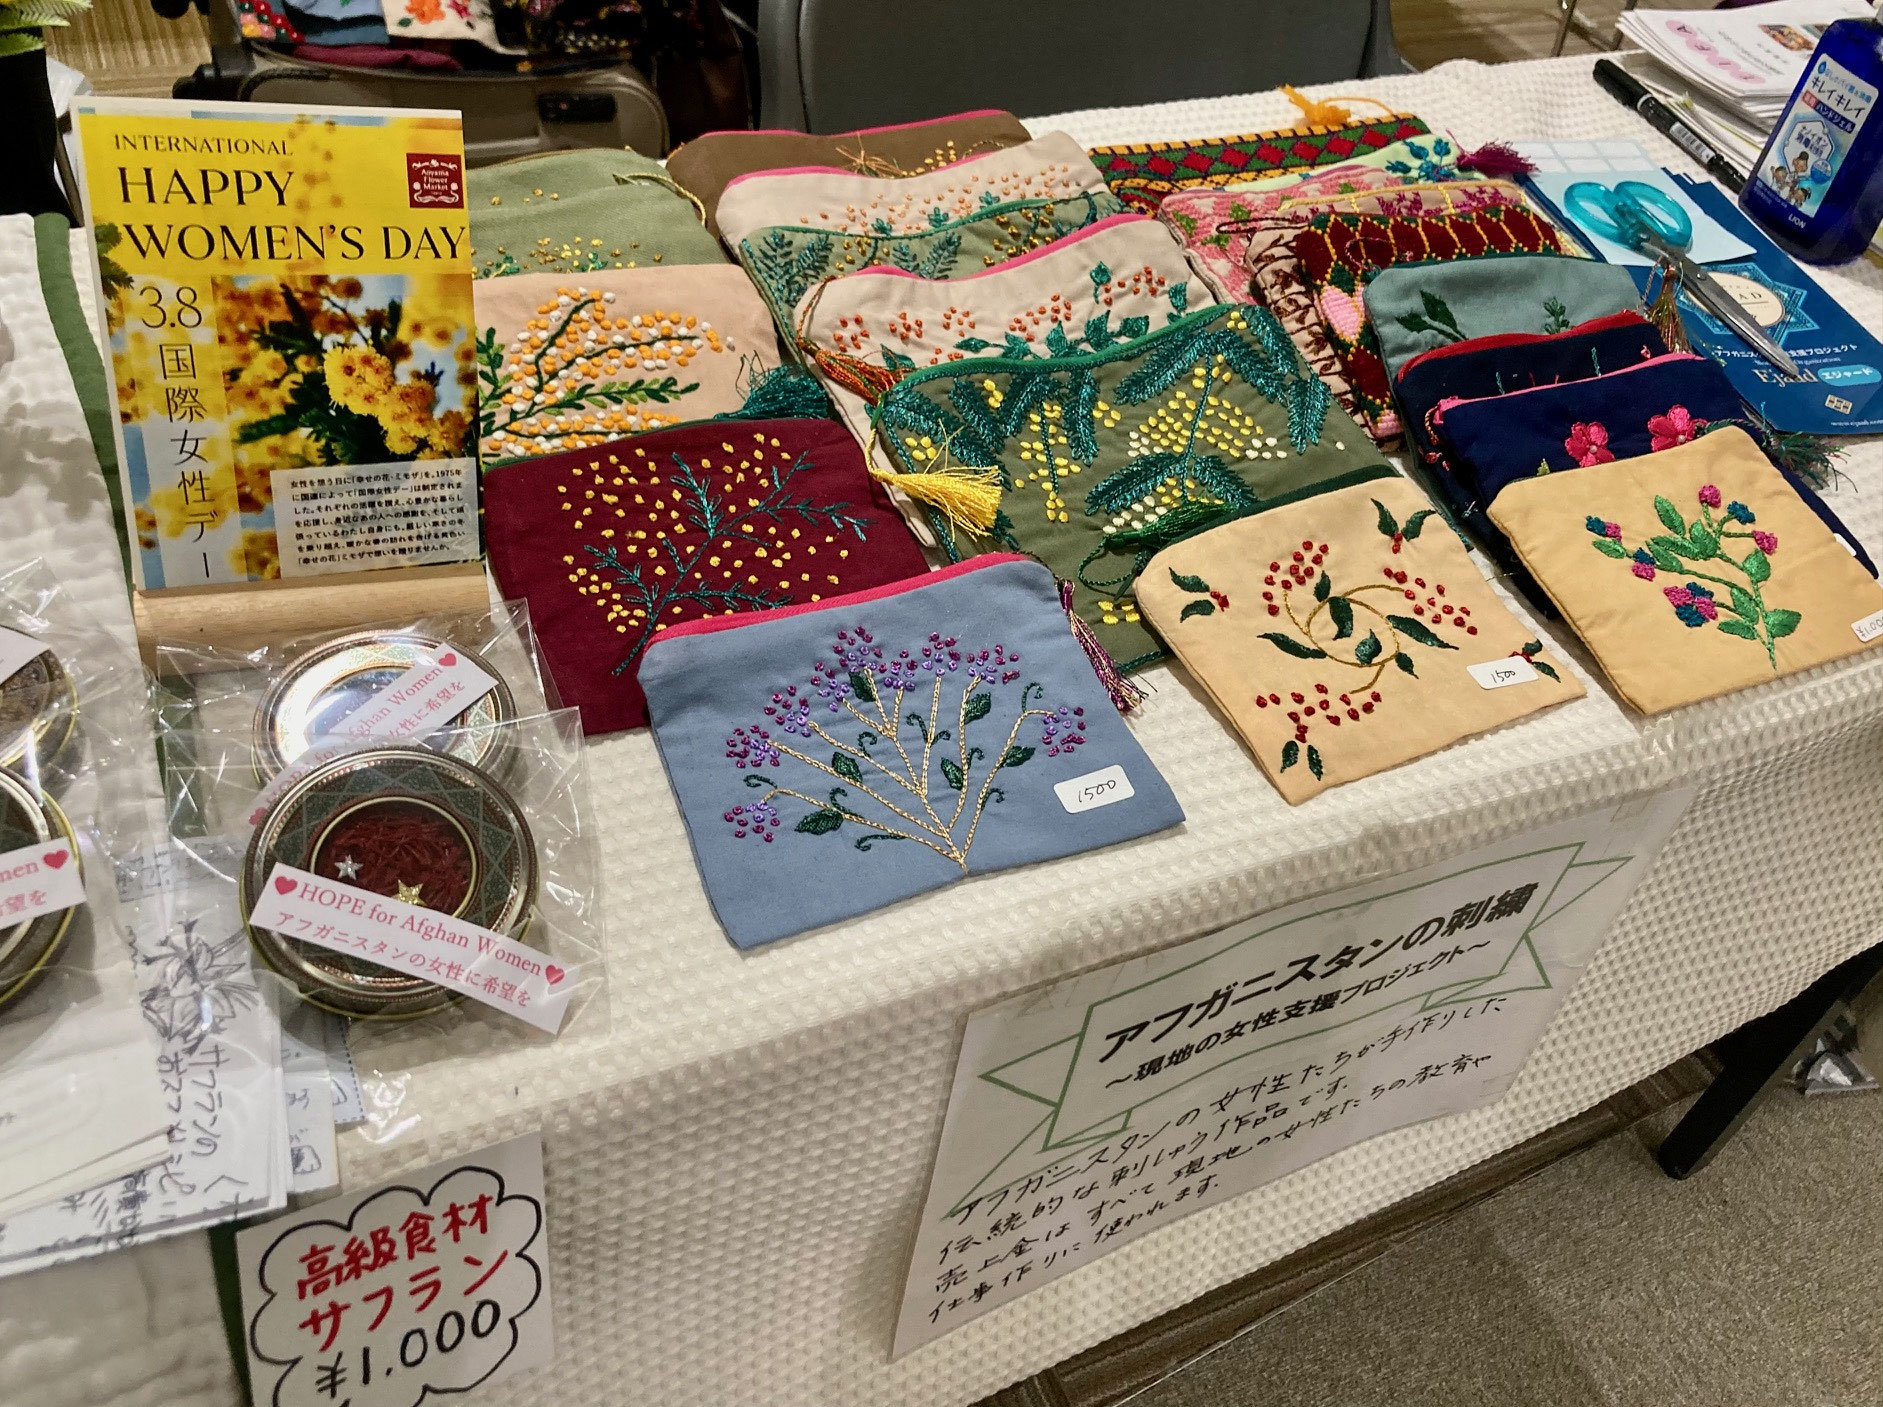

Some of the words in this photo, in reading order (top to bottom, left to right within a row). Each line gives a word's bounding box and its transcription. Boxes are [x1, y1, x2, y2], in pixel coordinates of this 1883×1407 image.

[1811, 76, 1866, 119] キレイキレイ
[114, 134, 294, 156] INTERNATIONAL
[118, 166, 294, 207] HAPPY
[124, 223, 364, 261] WOMEN'S
[383, 225, 466, 260] DAY
[1788, 213, 1807, 229] LION
[139, 286, 202, 329] 3.8
[1821, 367, 1873, 380] エジャード
[158, 343, 219, 578] 国際女性デー
[388, 667, 443, 706] Women
[1491, 670, 1516, 684] 1500
[1078, 780, 1116, 803] 1500
[297, 882, 364, 916] HOPE
[368, 904, 398, 926] for
[399, 914, 469, 948] Afghan
[477, 934, 541, 976] Women
[276, 911, 531, 1008] アフガニスタンの女性に希望を
[1098, 882, 1539, 1063] アフガニスタンの刺繍
[297, 1193, 493, 1300] 高級食材
[299, 1249, 509, 1353] サフラン
